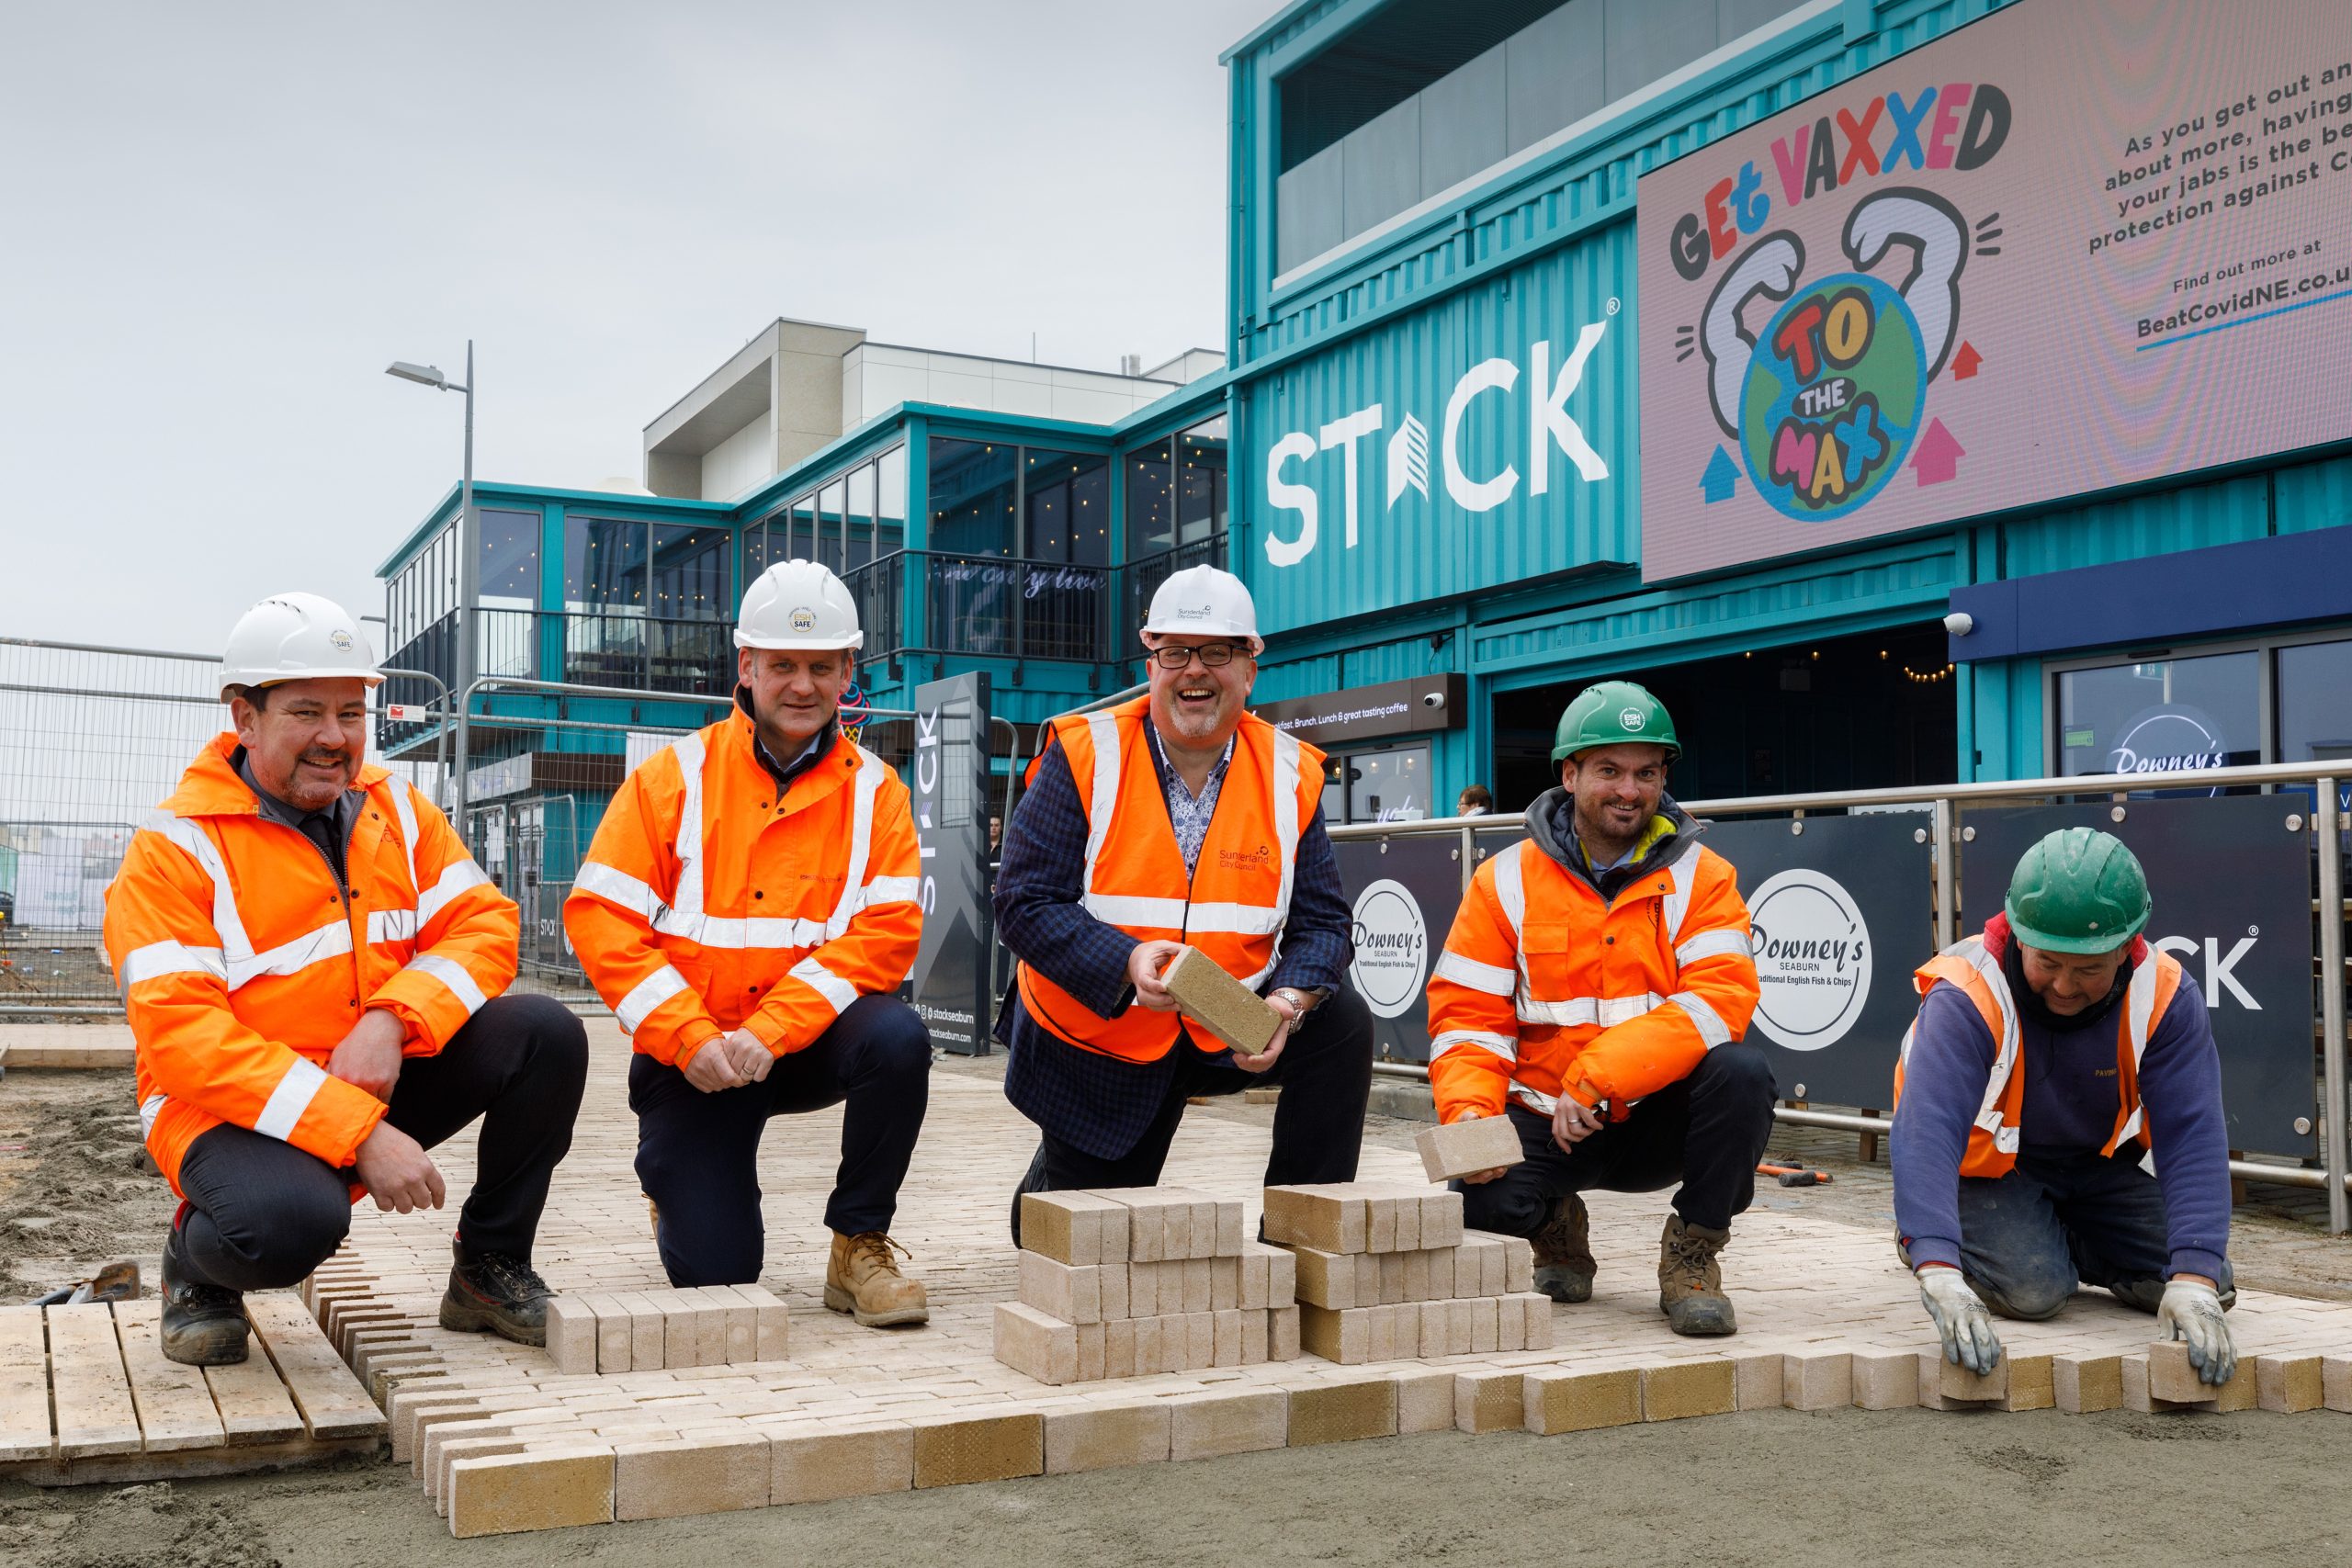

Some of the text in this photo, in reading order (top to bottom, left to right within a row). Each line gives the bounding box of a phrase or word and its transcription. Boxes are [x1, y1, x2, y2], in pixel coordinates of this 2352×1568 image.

[2105, 93, 2351, 191] about more, having
[2124, 135, 2153, 158] As
[2162, 116, 2205, 147] you
[2215, 94, 2256, 128] get
[2267, 74, 2310, 104] out
[1770, 84, 2012, 207] VAXXED
[2088, 151, 2352, 254] protection against C
[2118, 184, 2170, 217] your
[2178, 164, 2230, 198] jabs
[2239, 153, 2259, 174] is
[2268, 138, 2312, 163] the
[2173, 240, 2321, 293] Find out more at
[2137, 266, 2352, 338] BeatCovidNE.co.u
[1776, 292, 1871, 381] TO
[1799, 378, 1846, 416] THE
[1774, 401, 1883, 502] MAX
[1318, 713, 1337, 725] Lunch
[1338, 711, 1343, 721] &
[1343, 710, 1362, 724] great
[1362, 705, 1385, 718] tasting
[1385, 702, 1408, 715] coffee
[2110, 739, 2222, 774] Downey's
[1219, 860, 1256, 871] City Cuncil
[1352, 919, 1422, 957] Downey's
[1750, 922, 1863, 973] Downey's
[1378, 960, 1392, 968] English
[1405, 961, 1416, 969] Chips
[1758, 975, 1851, 987] raditional English Fish & Chips
[1780, 963, 1820, 971] SEABURN
